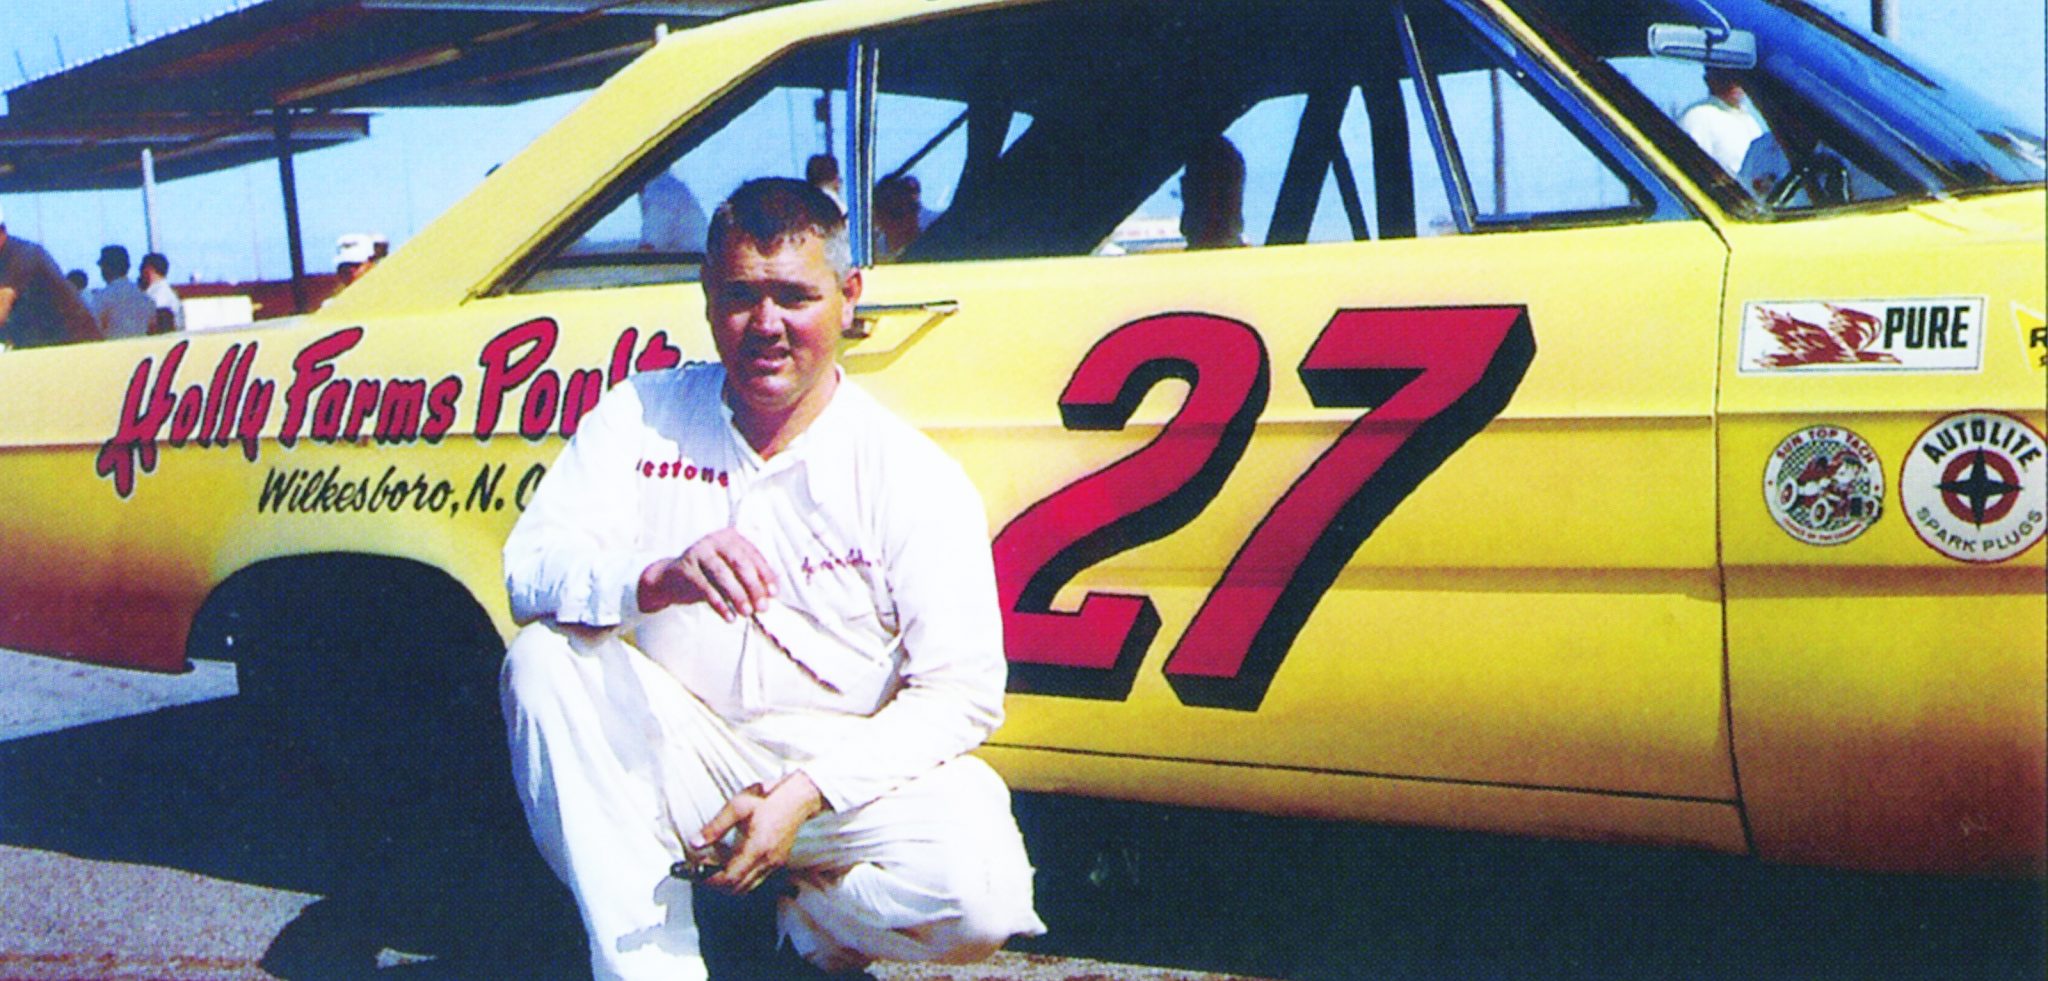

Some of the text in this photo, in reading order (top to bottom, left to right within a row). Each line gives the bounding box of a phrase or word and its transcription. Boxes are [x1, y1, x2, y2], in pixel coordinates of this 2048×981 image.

[1883, 305, 1971, 350] PURE
[96, 340, 274, 498] Holly
[279, 326, 463, 447] Farms
[1922, 418, 2042, 470] AUTOLITE
[990, 303, 1537, 712] 27
[1915, 506, 1976, 552] SPARK
[1982, 508, 2043, 552] PLUGS
